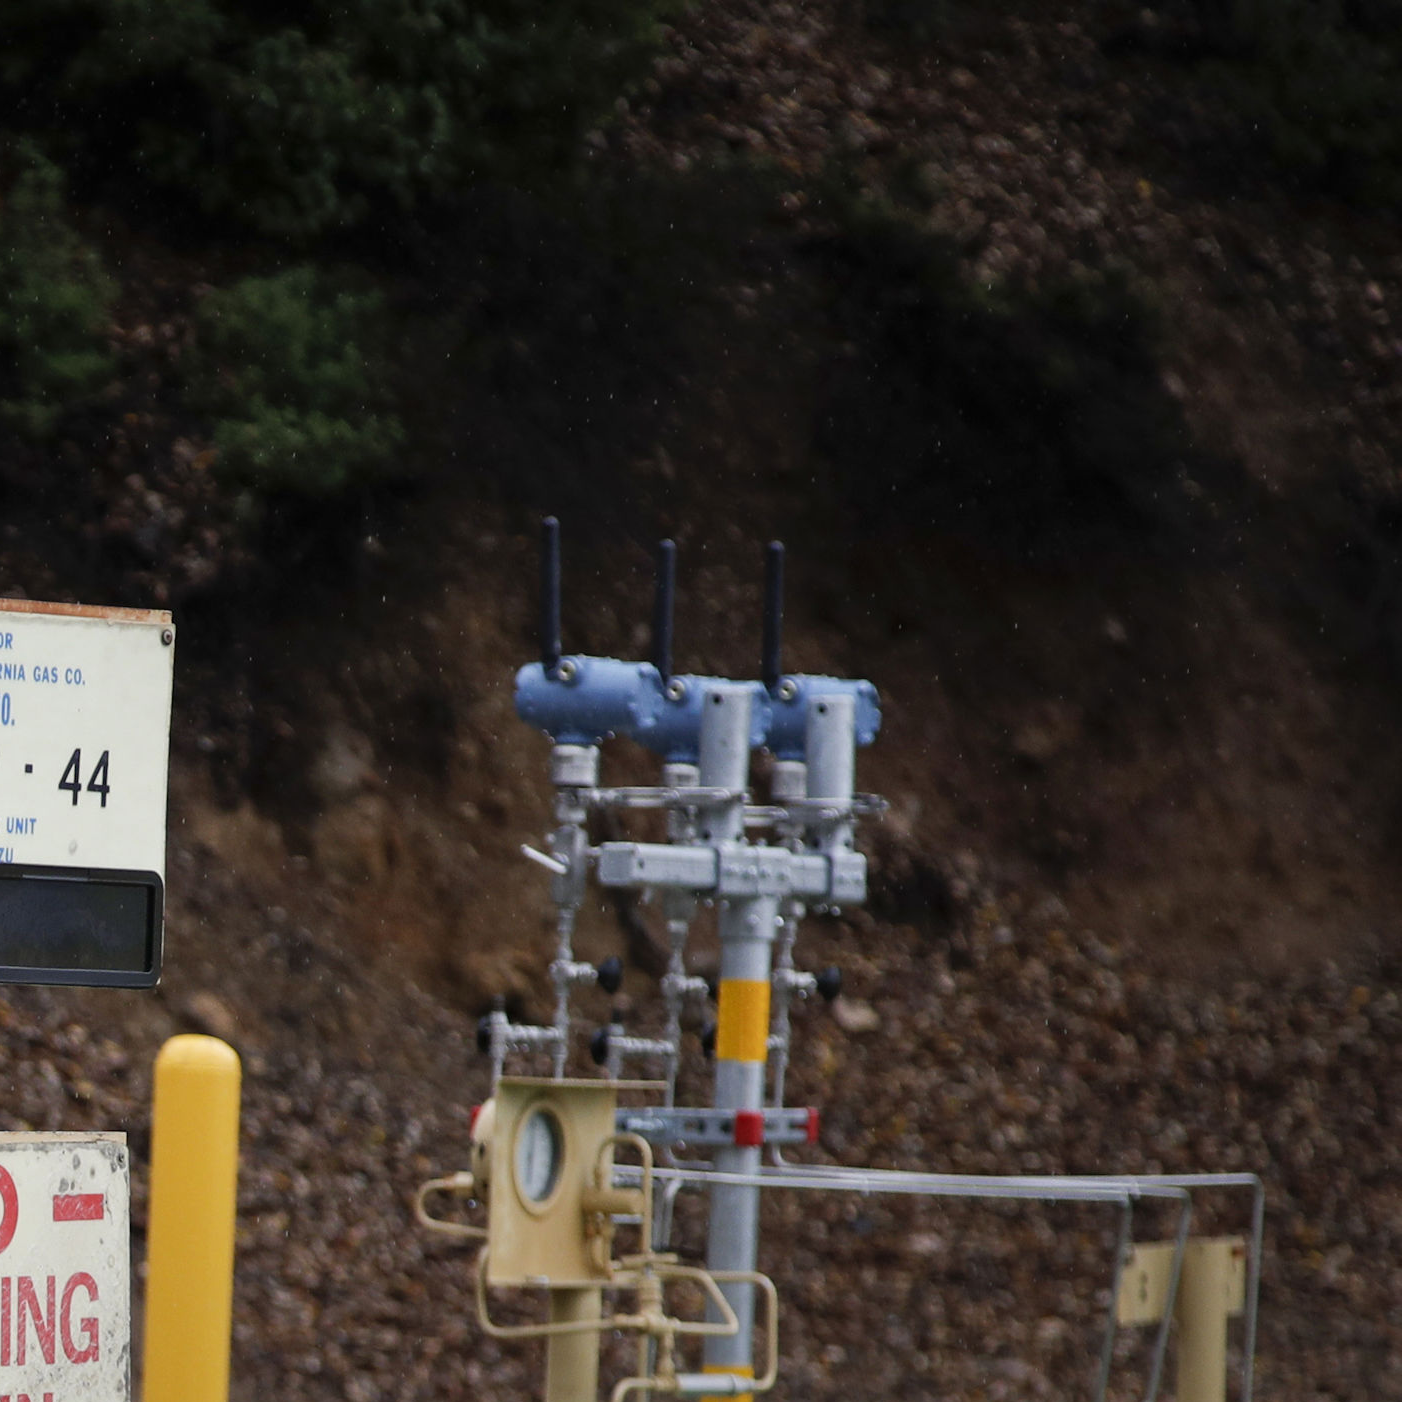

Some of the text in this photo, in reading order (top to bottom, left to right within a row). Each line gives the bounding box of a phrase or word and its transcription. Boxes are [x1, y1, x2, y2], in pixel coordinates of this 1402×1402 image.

[33, 666, 58, 683] GAS
[65, 668, 86, 685] CO.
[58, 748, 111, 808] 44
[6, 817, 37, 834] UNIT
